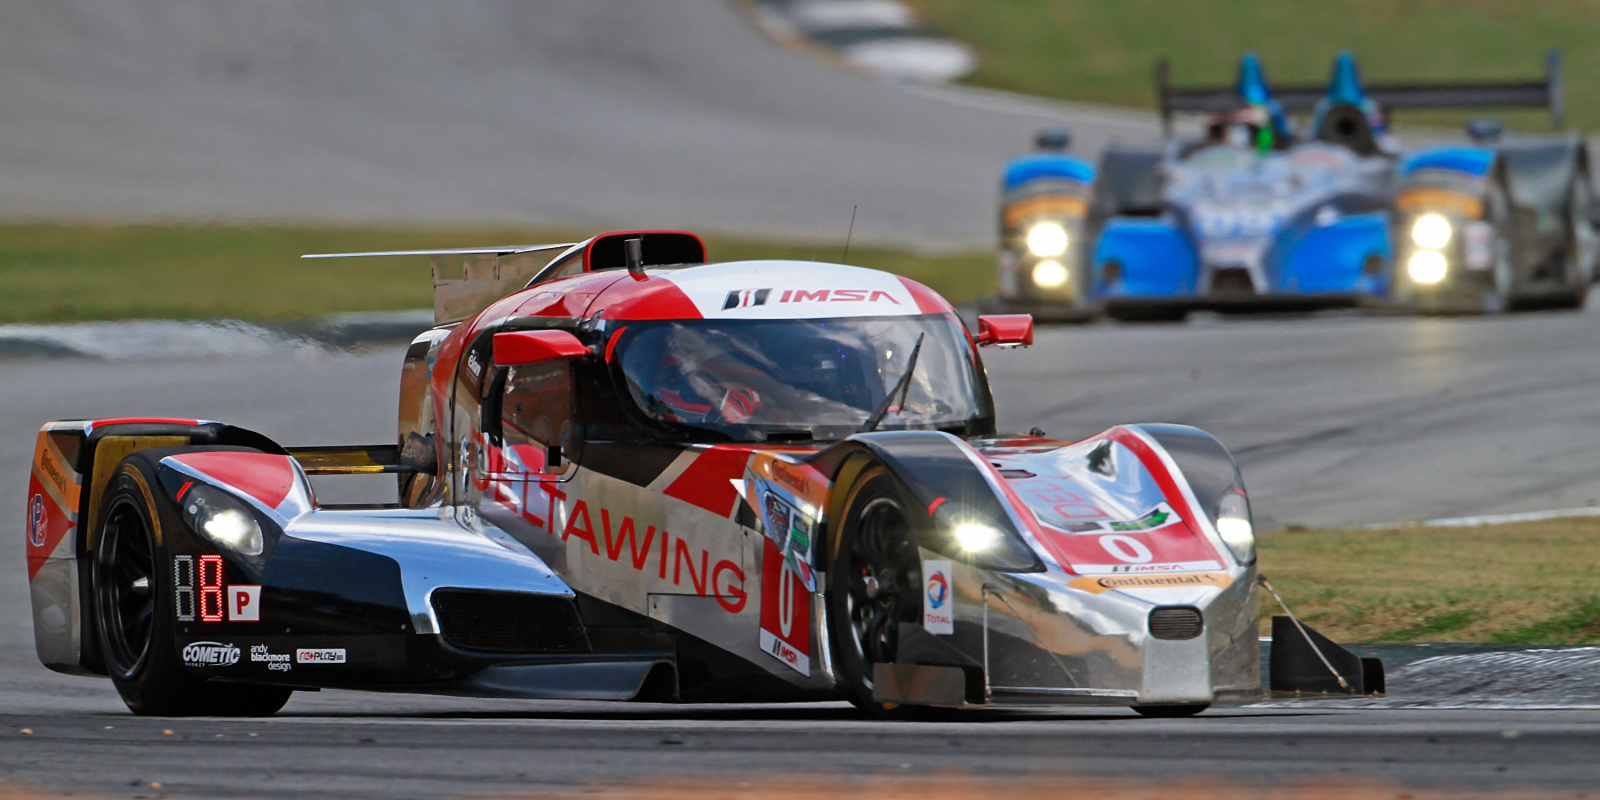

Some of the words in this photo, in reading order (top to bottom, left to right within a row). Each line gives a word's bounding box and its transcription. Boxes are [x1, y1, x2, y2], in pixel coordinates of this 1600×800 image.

[779, 289, 901, 305] IMSA
[471, 427, 748, 615] DELTAWING
[1098, 534, 1153, 563] 0
[1097, 574, 1202, 588] Continental
[236, 591, 250, 615] P
[779, 557, 793, 639] 0
[926, 613, 951, 624] TOTAL
[182, 643, 241, 664] COMETIC
[250, 643, 268, 655] andy
[250, 652, 290, 662] blackmore
[780, 645, 798, 666] IMSA
[267, 661, 292, 672] design
